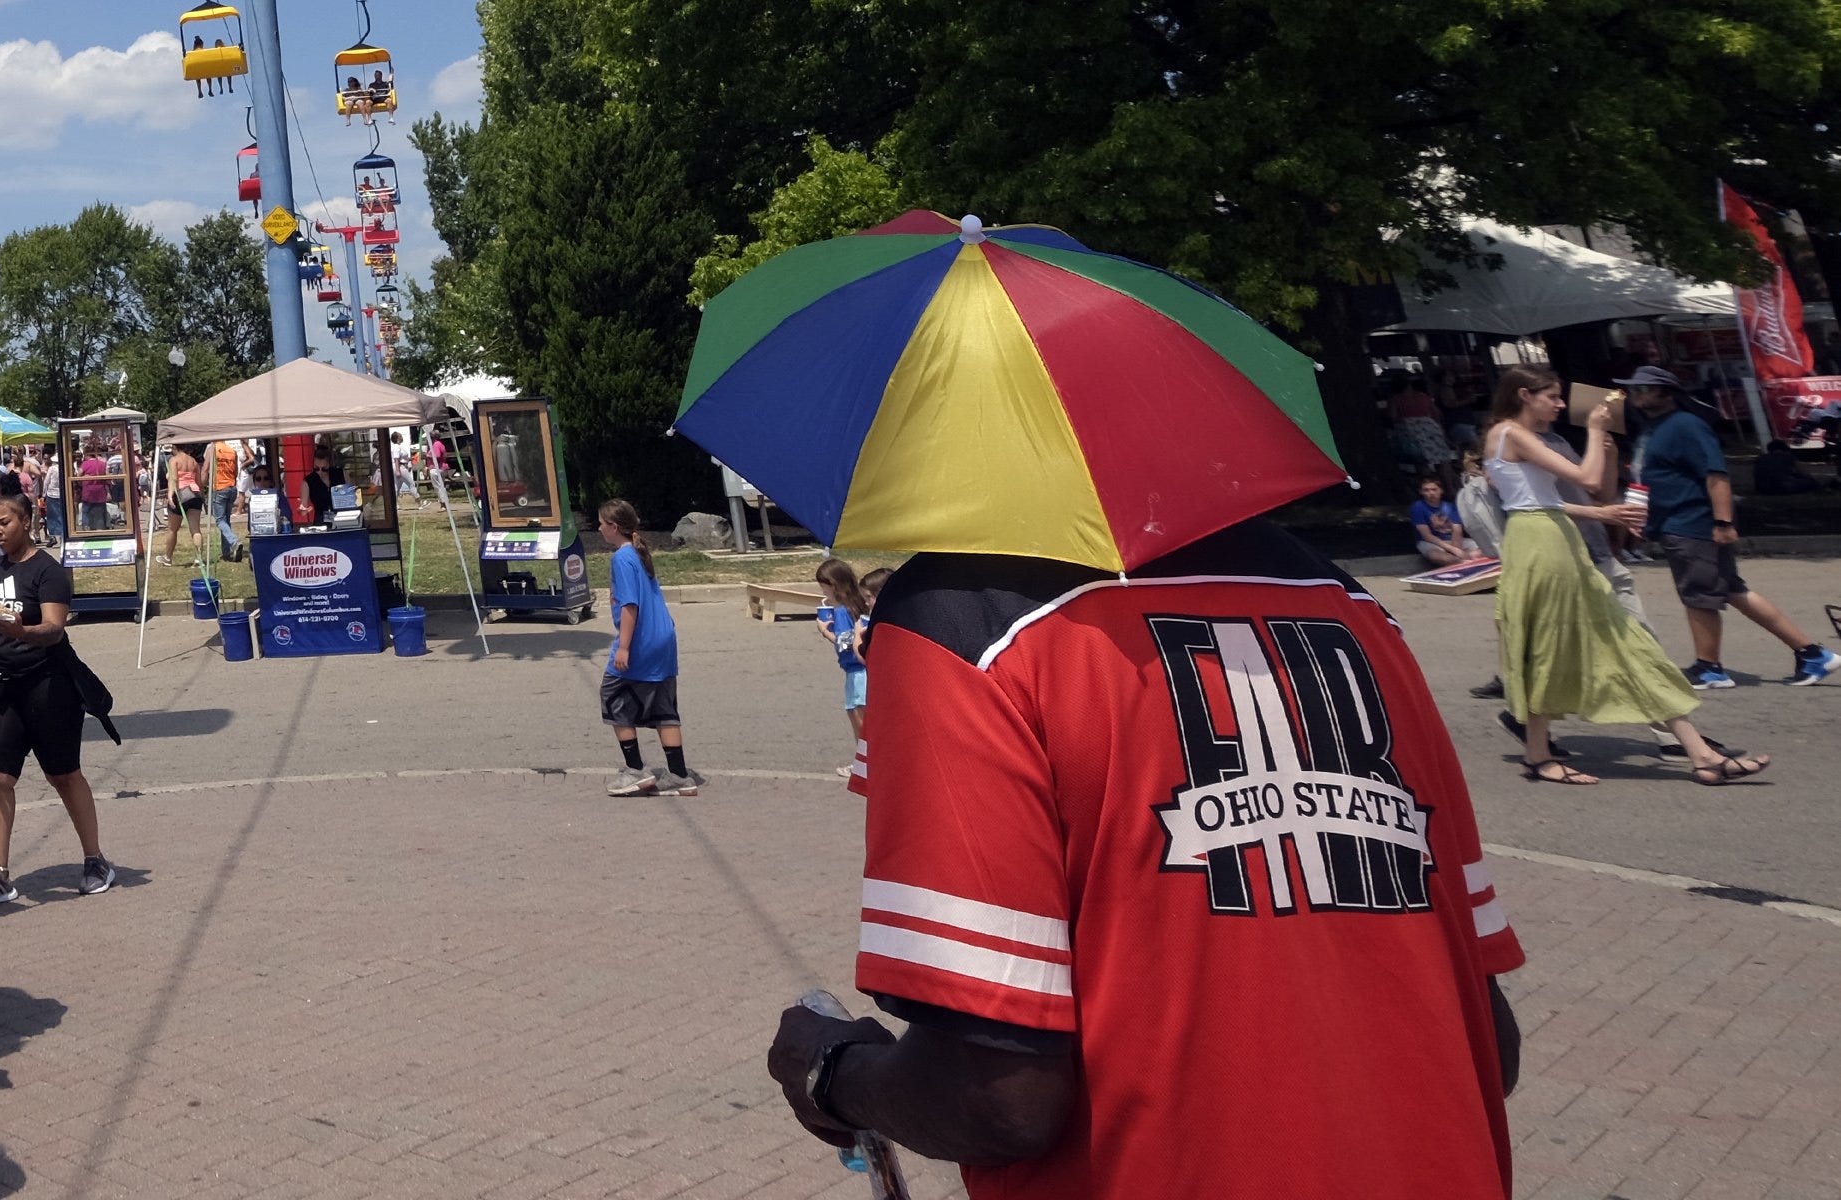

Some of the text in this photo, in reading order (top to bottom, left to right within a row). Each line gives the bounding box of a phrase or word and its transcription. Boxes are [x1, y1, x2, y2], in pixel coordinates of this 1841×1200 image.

[283, 552, 338, 567] Universal
[284, 566, 337, 579] Windows
[1194, 782, 1419, 835] OHIO STATE
